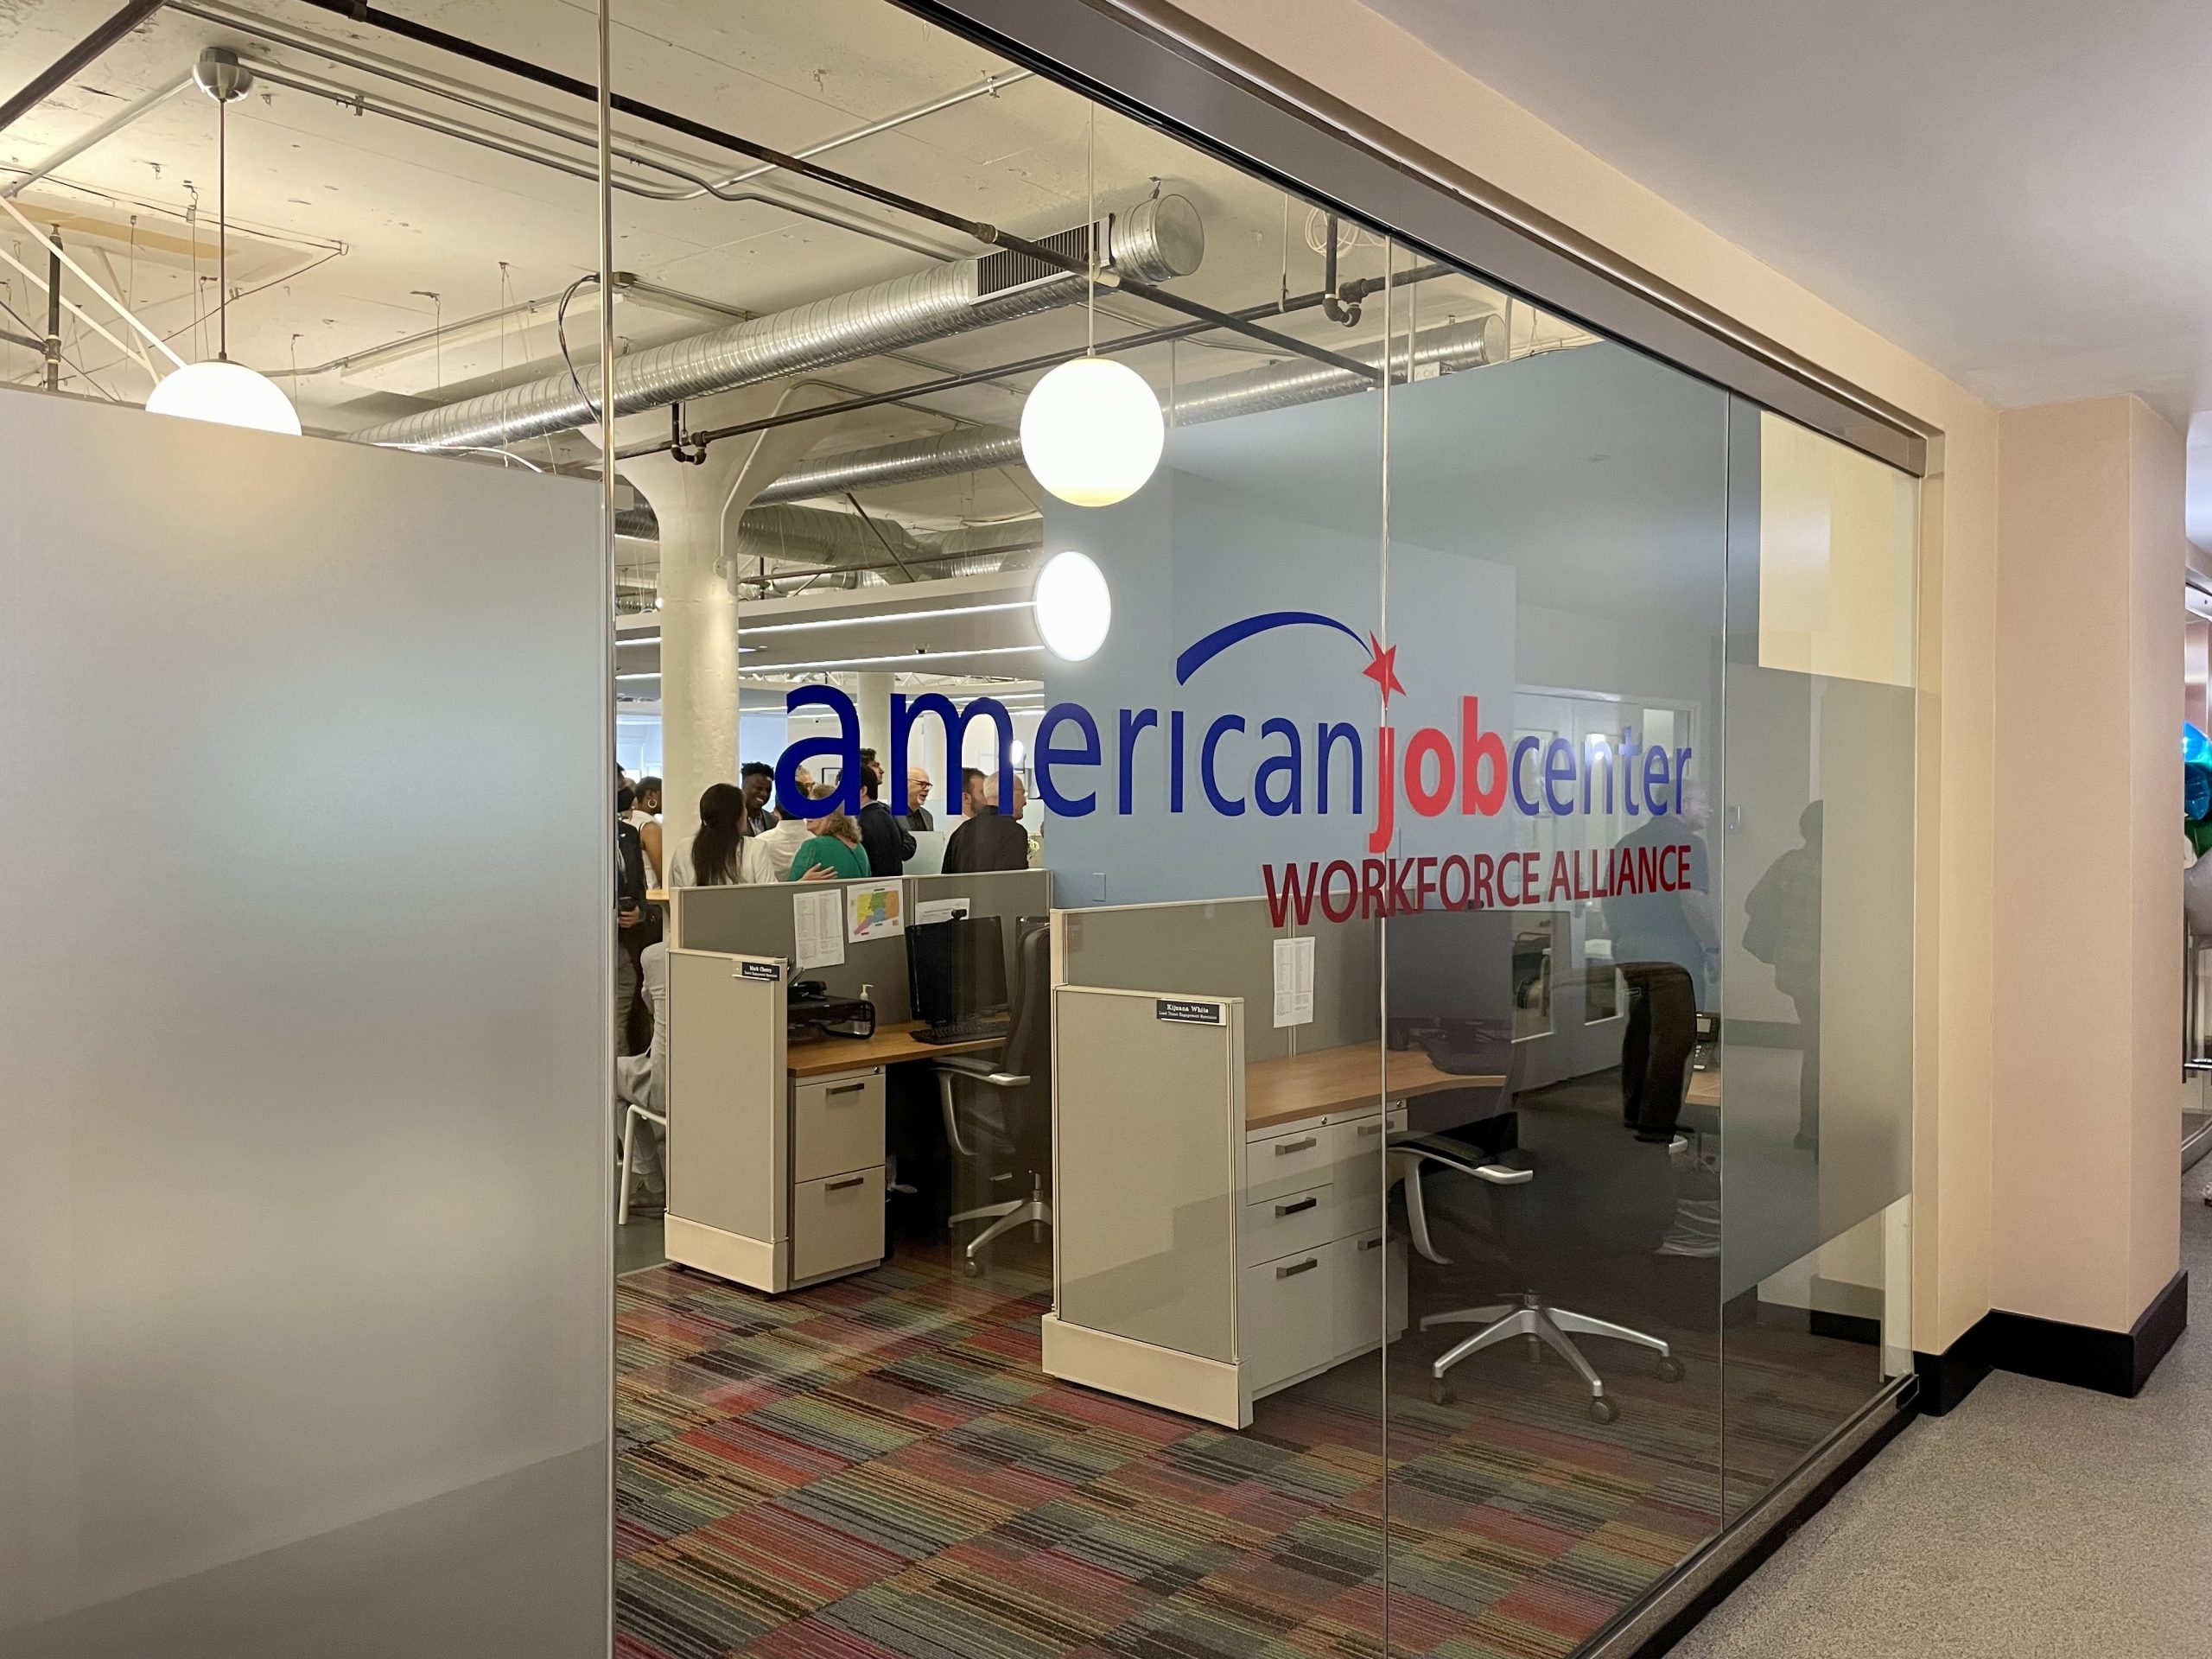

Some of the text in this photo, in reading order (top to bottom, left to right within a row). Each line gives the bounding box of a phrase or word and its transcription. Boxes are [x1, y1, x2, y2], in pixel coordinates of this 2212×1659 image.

[1262, 844, 1691, 928] WORKFORCE ALLIANCE
[1191, 1005, 1210, 1014] White
